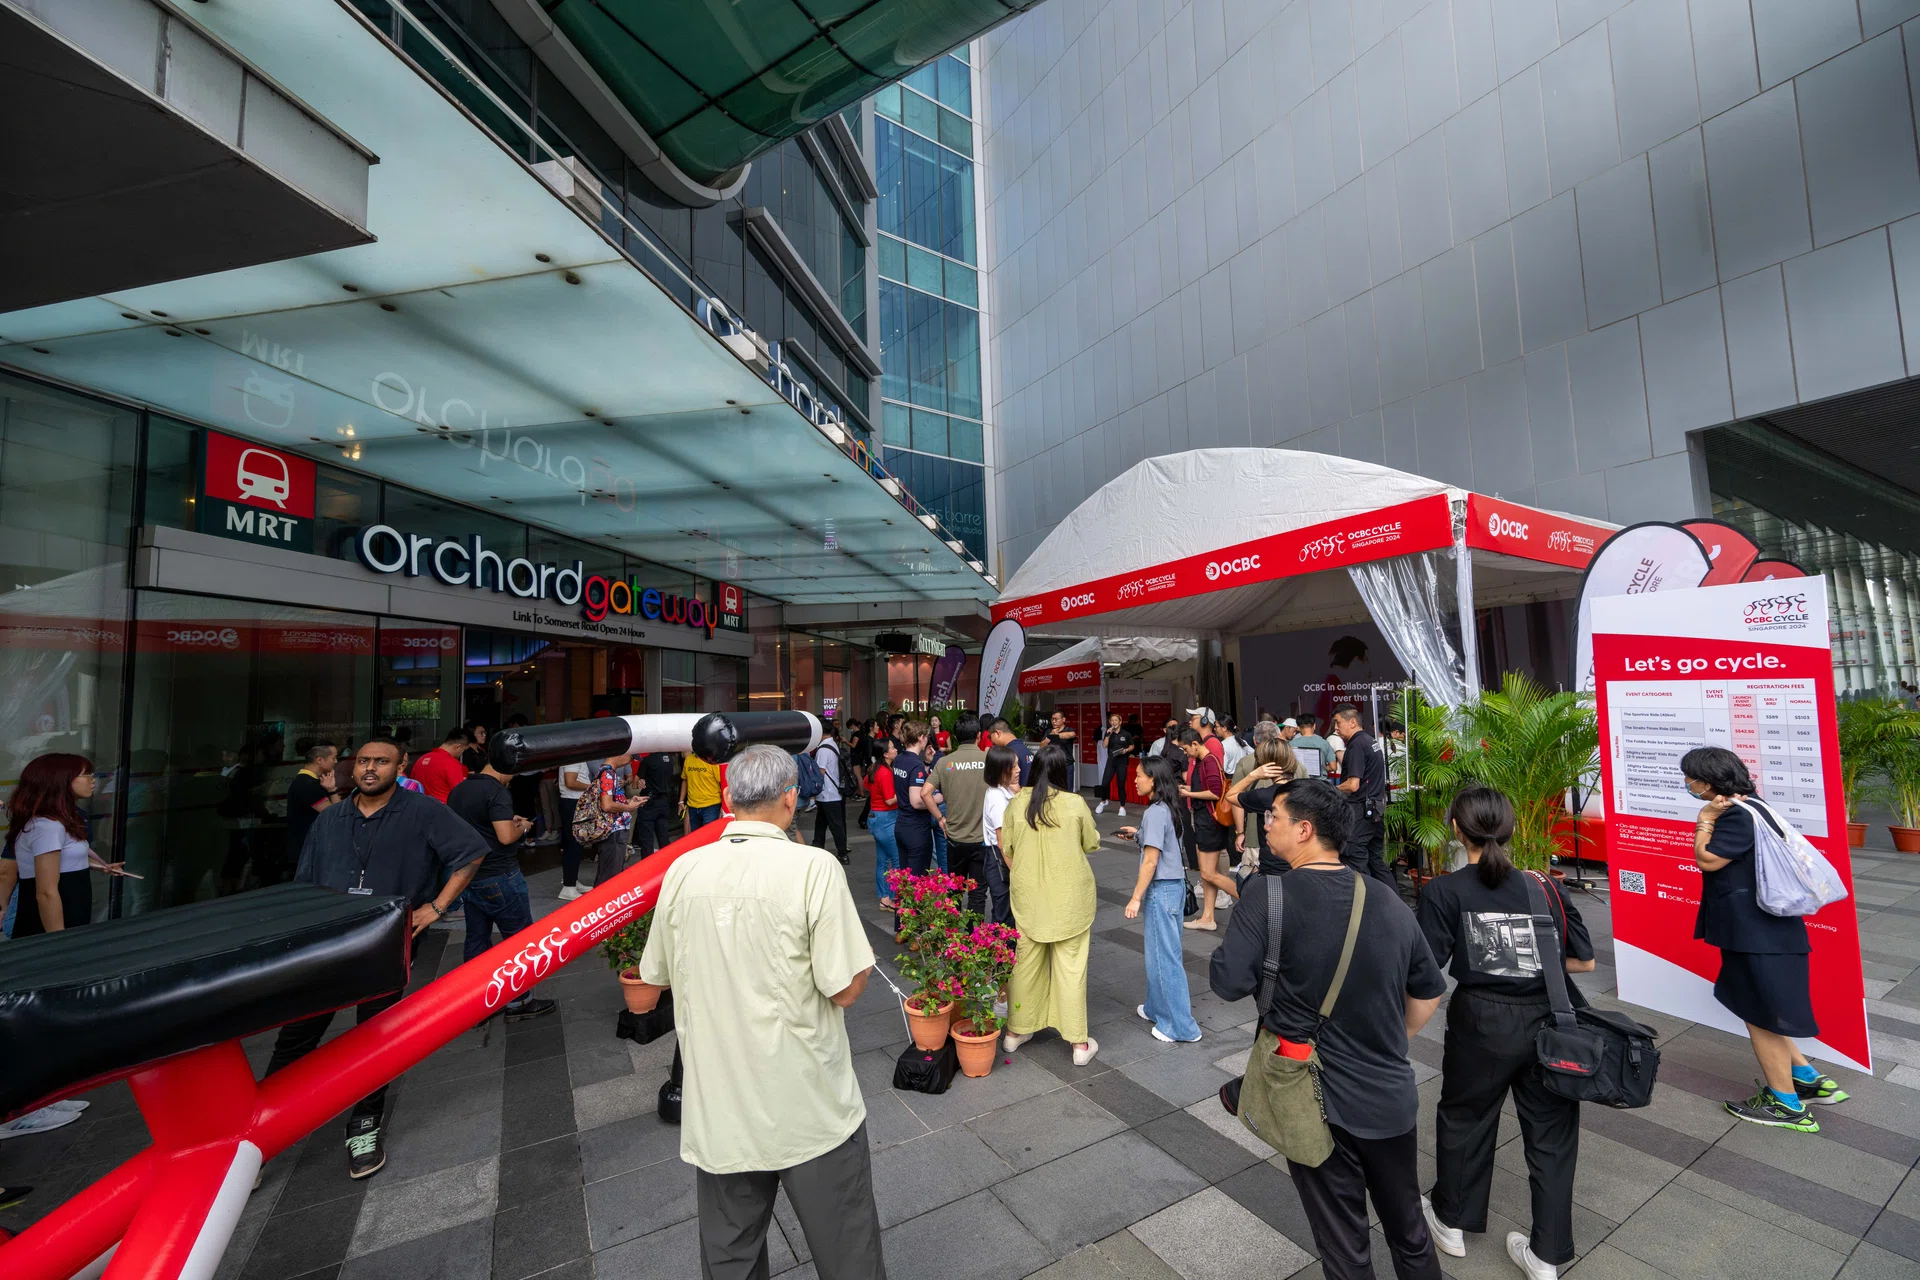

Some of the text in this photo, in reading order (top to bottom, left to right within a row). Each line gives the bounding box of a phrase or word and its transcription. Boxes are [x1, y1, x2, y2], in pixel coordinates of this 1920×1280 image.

[226, 506, 298, 542] MRT
[1348, 521, 1402, 540] OCBC CYCLE
[1501, 519, 1529, 541] OCBC
[1352, 534, 1401, 549] SINGAPORE 2024
[1221, 554, 1261, 575] OCBC
[356, 524, 718, 640] orchardgateway
[1146, 573, 1176, 586] OCBC CYCLE
[1071, 592, 1095, 608] OCBC
[513, 610, 645, 639] Link To Somerset Road Open 24 Hours
[723, 614, 740, 629] MRT
[1745, 613, 1809, 624] OCBC CYCLE
[1748, 624, 1787, 632] SINGAPORE
[1677, 658, 1708, 674] go
[1715, 652, 1787, 672] cycle.
[1074, 670, 1092, 681] OCBC
[1303, 683, 1326, 692] OCBC
[1327, 683, 1335, 691] in
[1333, 695, 1352, 703] over
[1354, 693, 1368, 702] the
[1630, 834, 1656, 843] cashback
[1670, 840, 1694, 848] paymen
[1667, 894, 1684, 903] OCBC
[570, 886, 644, 935] OCBC CYCLE
[590, 909, 633, 941] SINGAPORE
